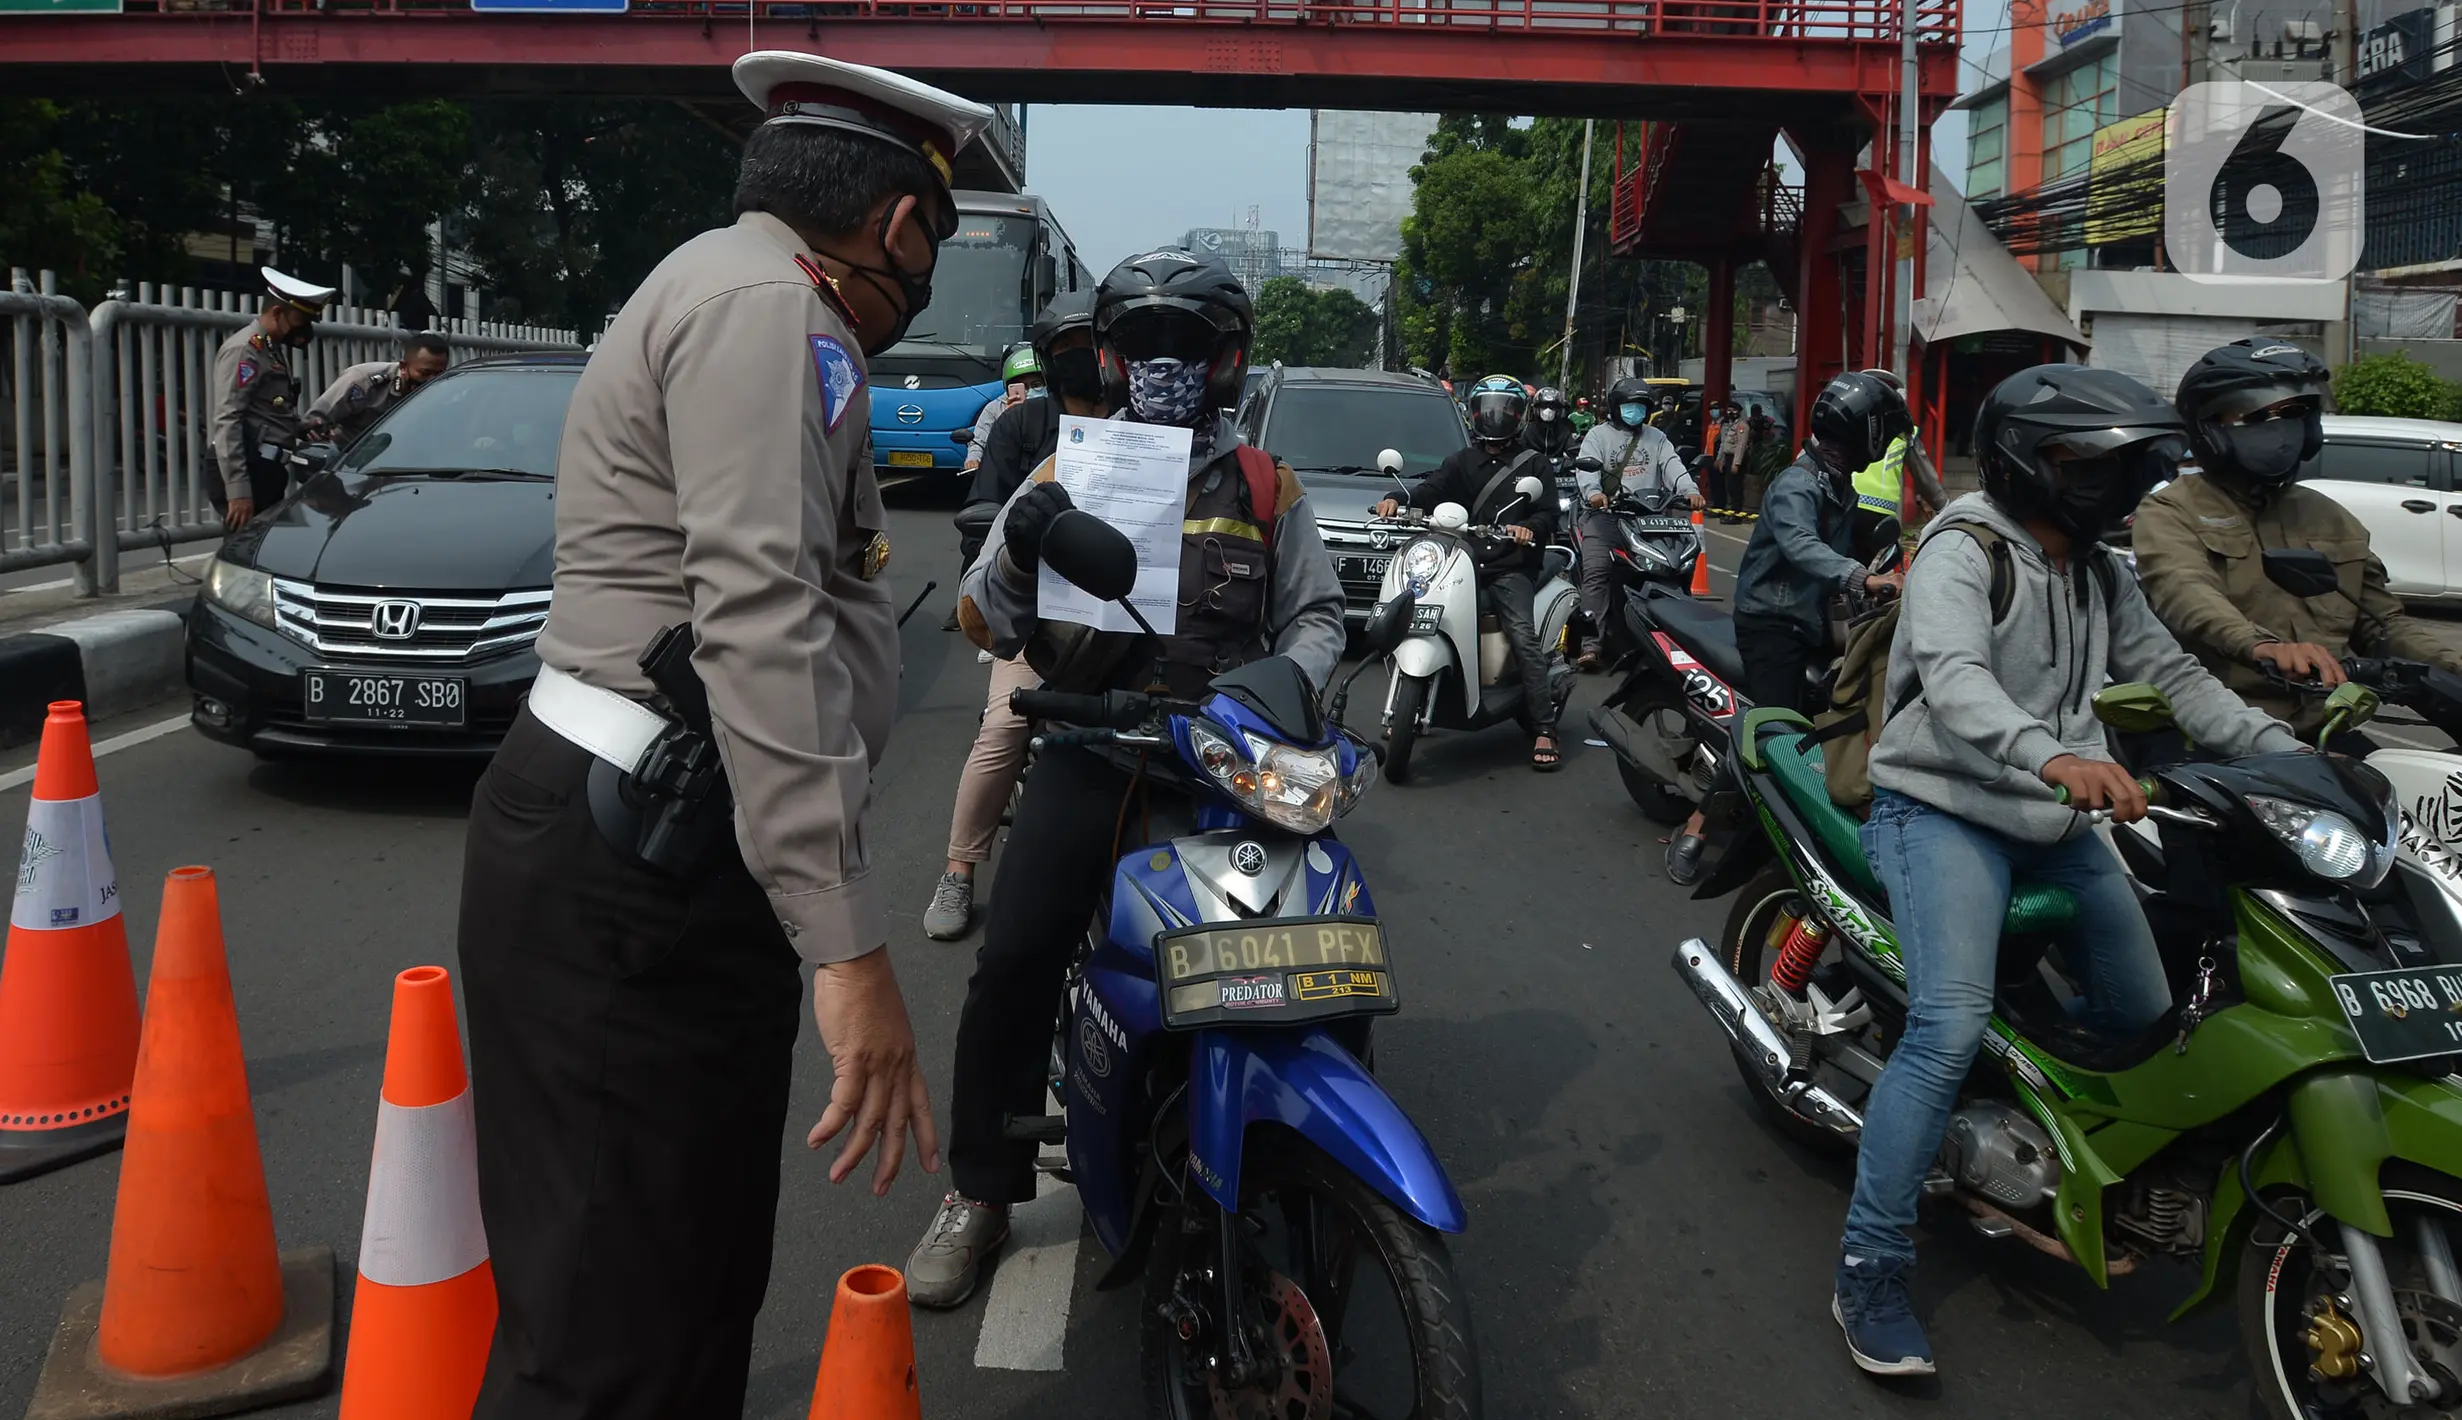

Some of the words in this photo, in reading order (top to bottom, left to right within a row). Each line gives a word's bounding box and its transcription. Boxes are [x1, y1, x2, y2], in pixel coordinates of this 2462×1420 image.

[1338, 557, 1347, 573] F
[1416, 608, 1438, 620] SAH
[310, 676, 324, 703] B
[349, 678, 404, 706] 2867
[2398, 810, 2462, 880] DAKA
[1170, 945, 1191, 979] B
[1217, 932, 1296, 972] 6041
[1317, 929, 1376, 964] PFX
[1302, 976, 1313, 988] B
[1327, 973, 1338, 985] 1
[1350, 972, 1374, 985] NM
[1331, 986, 1352, 995] 213
[1221, 983, 1283, 1003] PREDATOR
[2337, 983, 2363, 1017] B
[2370, 978, 2439, 1013] 6968
[1083, 977, 1129, 1054] YAMAHA
